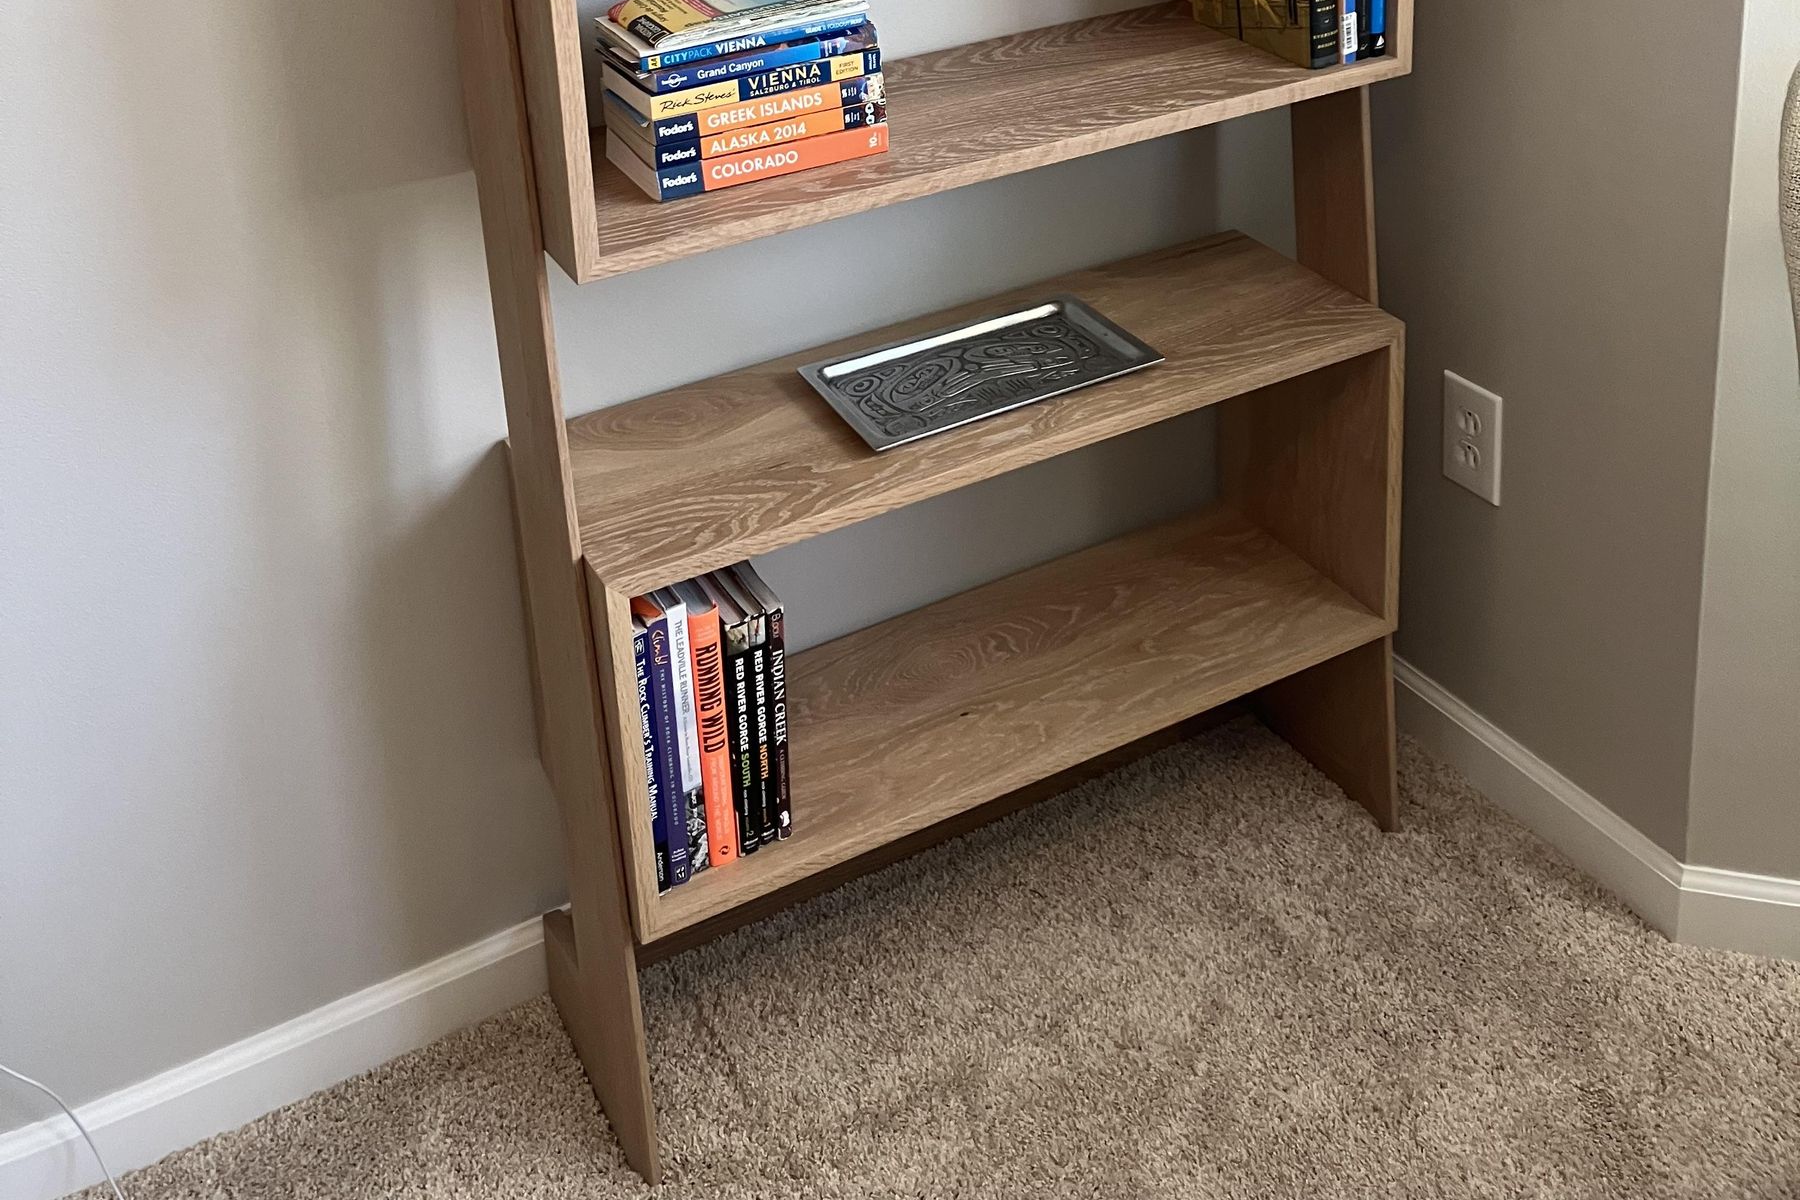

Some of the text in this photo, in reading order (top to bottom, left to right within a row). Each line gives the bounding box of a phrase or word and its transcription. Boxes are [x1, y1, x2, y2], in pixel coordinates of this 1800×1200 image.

[663, 36, 766, 64] CITYPACK VIENNA
[839, 60, 854, 68] FIRST
[697, 59, 764, 79] Grand Canyon
[747, 63, 822, 90] VIENNA
[836, 66, 858, 75] EDITION
[749, 81, 790, 97] SALZBURG
[799, 77, 821, 86] TIROL
[660, 99, 693, 112] Rick
[707, 93, 823, 128] GREEK ISLANDS
[659, 120, 693, 137] Fodor's
[710, 121, 807, 154] ALASKA 2014
[661, 147, 696, 163] Fodor's
[711, 150, 799, 180] COLORADO
[662, 172, 697, 189] Fodor's
[674, 619, 683, 637] THE
[637, 658, 646, 678] THE
[675, 637, 687, 681] LEADVILLE
[639, 675, 650, 702] ROCK
[695, 642, 722, 711] RUNNING
[772, 649, 787, 746] INDIAN CREEK
[735, 657, 751, 788] RED RIVER GORGE SOUTH
[753, 649, 769, 780] RED RIVER GORGE NORTH
[701, 709, 726, 753] WILD
[644, 744, 655, 785] TRAINING
[648, 783, 658, 821] MANUAL
[671, 791, 679, 825] COLORADO
